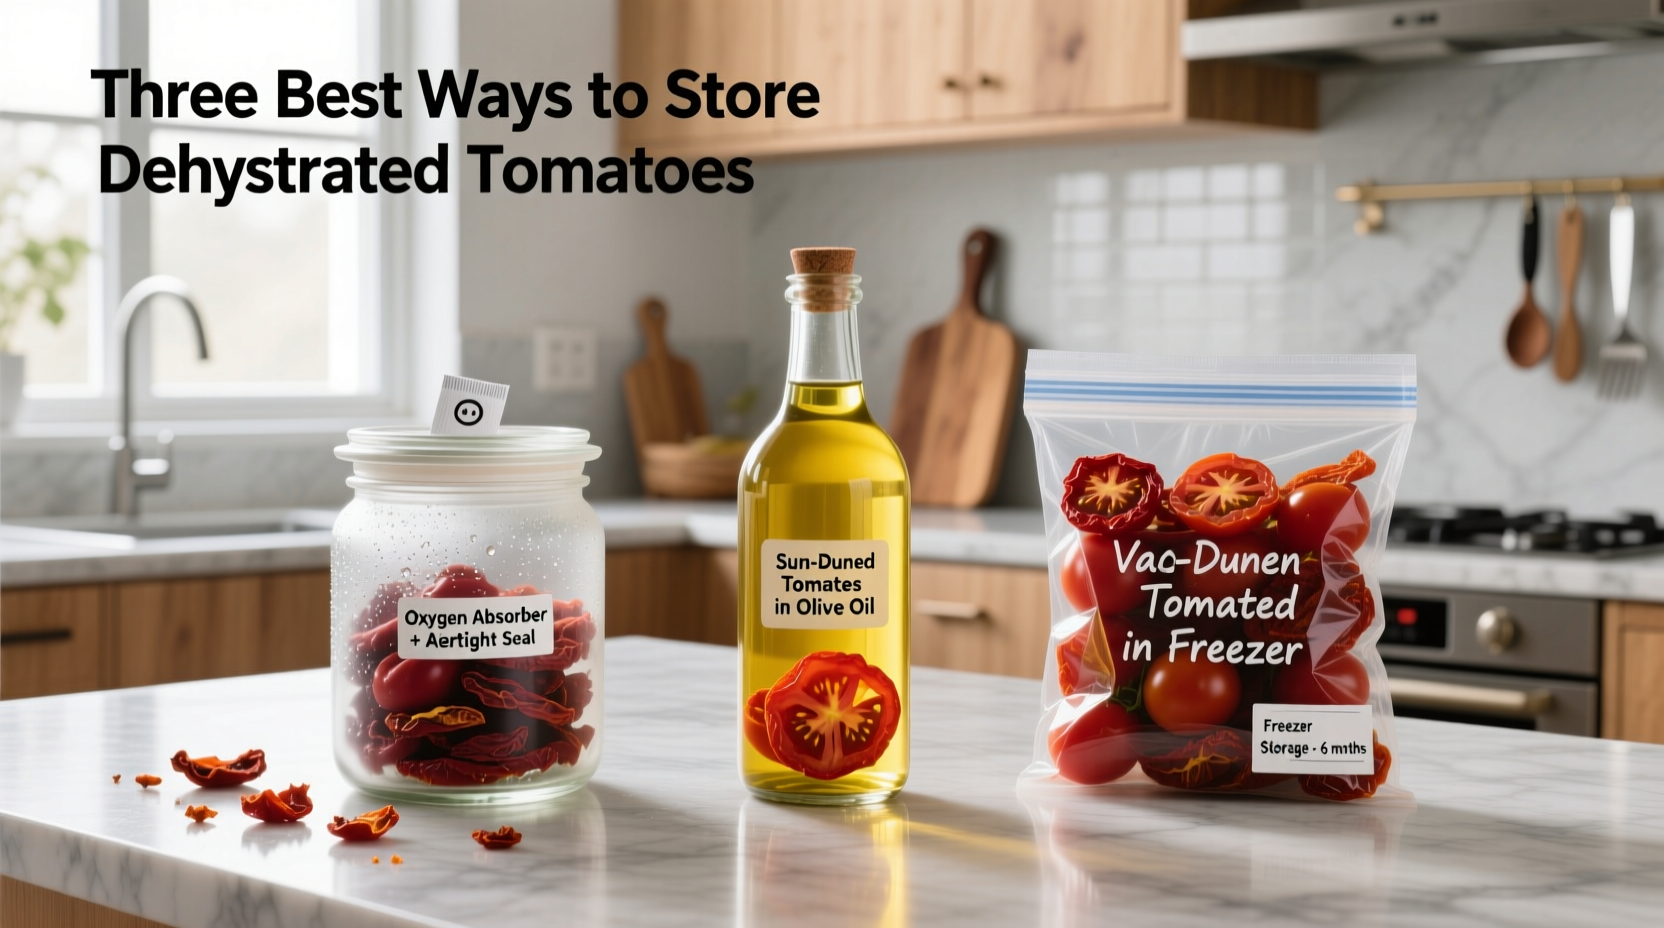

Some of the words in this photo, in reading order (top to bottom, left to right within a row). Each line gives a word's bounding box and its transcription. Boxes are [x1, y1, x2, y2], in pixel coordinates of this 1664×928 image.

[776, 552, 875, 569] Sun-Duned
[781, 575, 862, 592] Tomates
[775, 598, 790, 615] in
[796, 598, 844, 615] Olive
[849, 597, 874, 615] Oil
[1140, 583, 1299, 620] Tomated
[405, 609, 467, 629] Oxygen
[472, 606, 548, 625] Absorber
[410, 634, 421, 646] +
[426, 631, 497, 652] Aertight
[502, 629, 535, 646] Seal
[1122, 630, 1152, 661] in
[1168, 627, 1303, 665] Freezer
[1264, 719, 1313, 732] Freezer
[1320, 741, 1328, 754] 6
